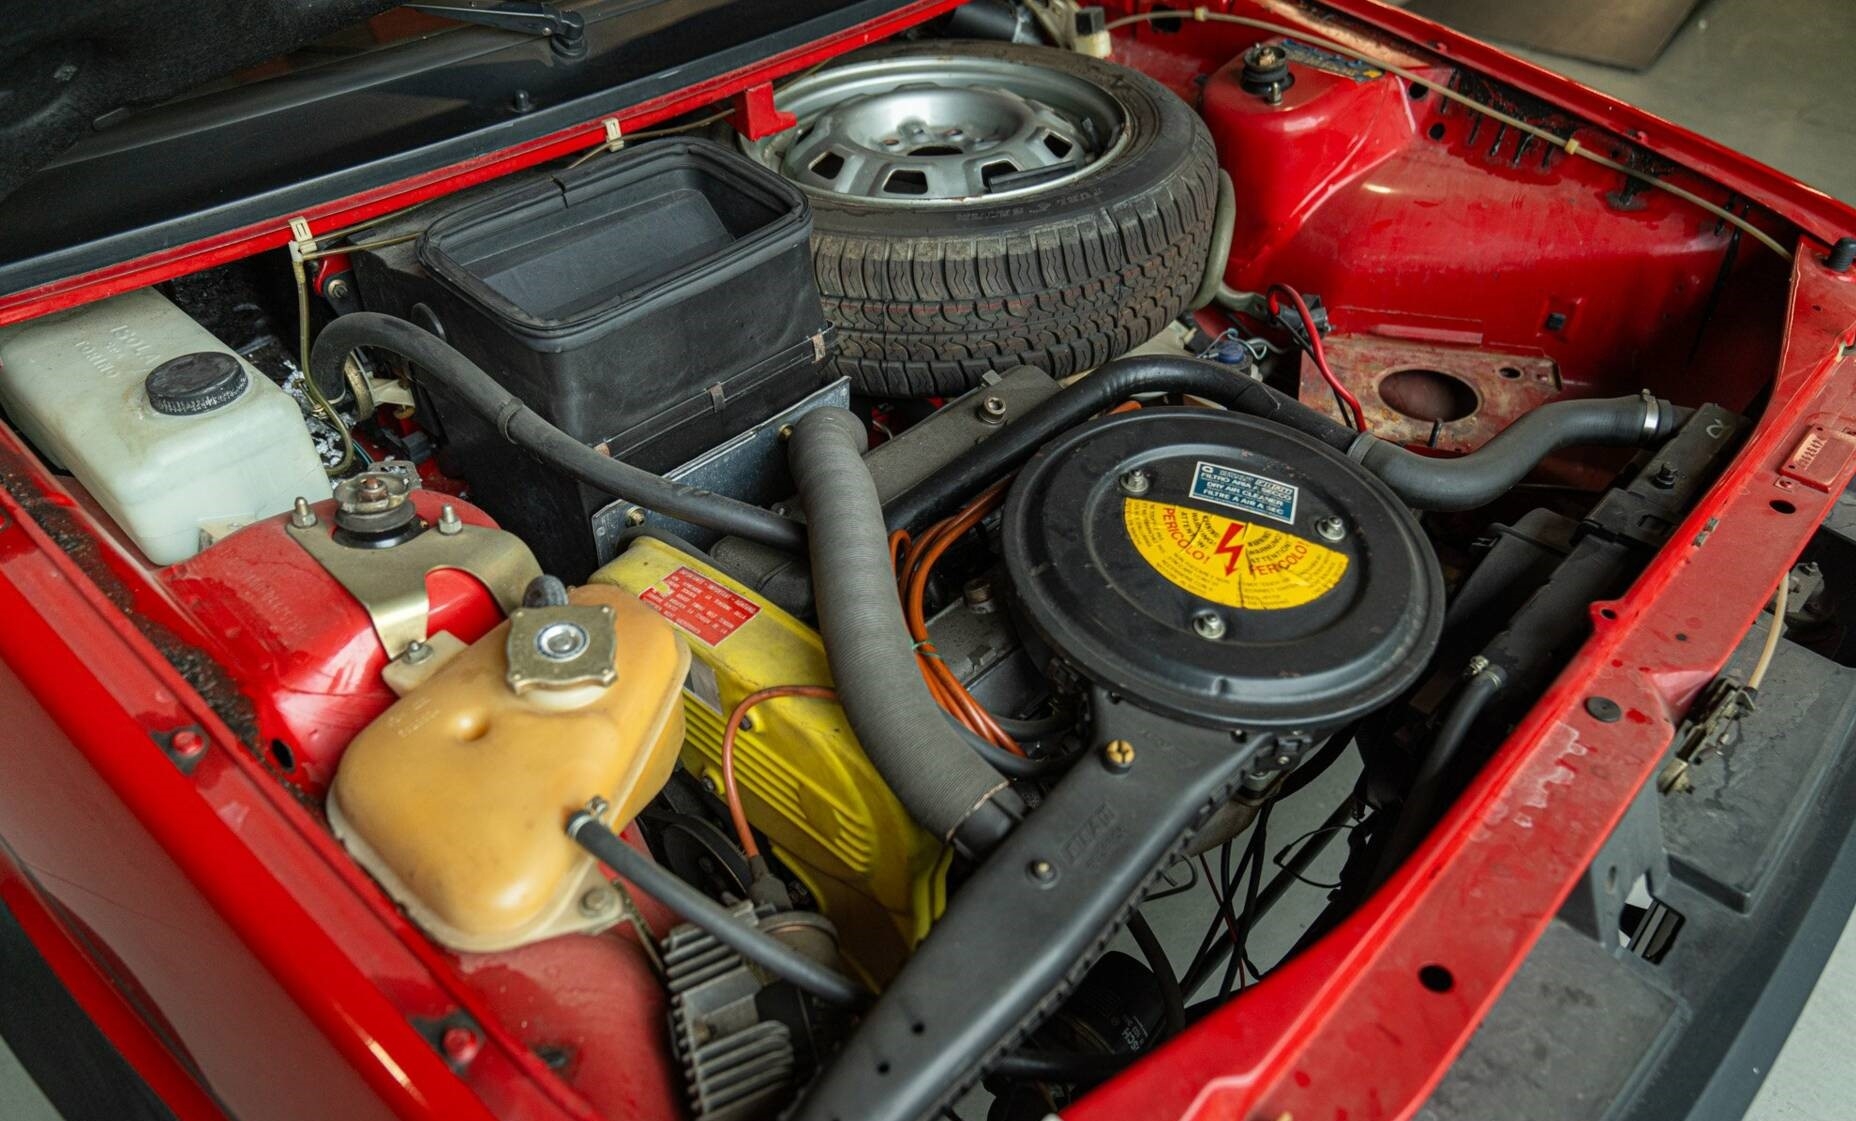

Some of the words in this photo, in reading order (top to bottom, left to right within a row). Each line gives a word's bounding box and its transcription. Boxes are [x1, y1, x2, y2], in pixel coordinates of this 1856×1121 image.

[1201, 472, 1230, 483] FILTRO
[1261, 487, 1292, 501] SECCO
[1206, 481, 1223, 489] DRY
[1242, 490, 1284, 506] CLEANER
[1203, 488, 1230, 499] FILTRE
[1266, 505, 1284, 515] SEC
[1163, 507, 1210, 564] PERICOLO!
